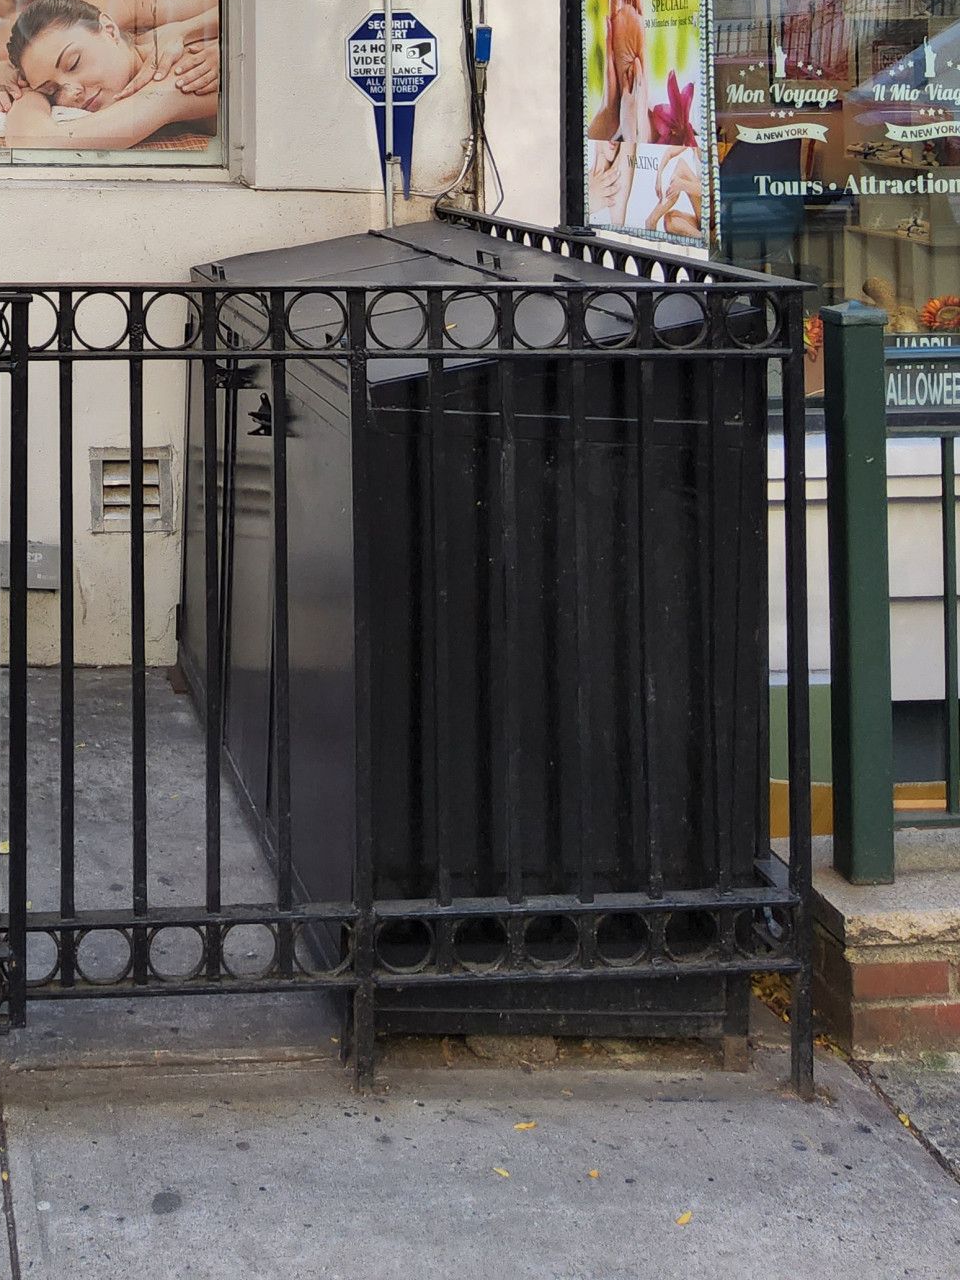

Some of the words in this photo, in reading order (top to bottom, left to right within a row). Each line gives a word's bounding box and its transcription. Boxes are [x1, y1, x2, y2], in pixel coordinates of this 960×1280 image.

[352, 44, 367, 53] 24
[366, 78, 381, 86] ALL
[382, 77, 425, 86] ATIVITIES
[726, 83, 765, 103] Mon
[769, 83, 839, 109] Voyage
[890, 83, 921, 101] Mio
[763, 132, 784, 141] NEW
[784, 128, 808, 138] YORK
[909, 128, 933, 139] NEW
[627, 155, 658, 171] WAXING
[754, 175, 824, 196] Tours
[843, 172, 960, 195] Attraction
